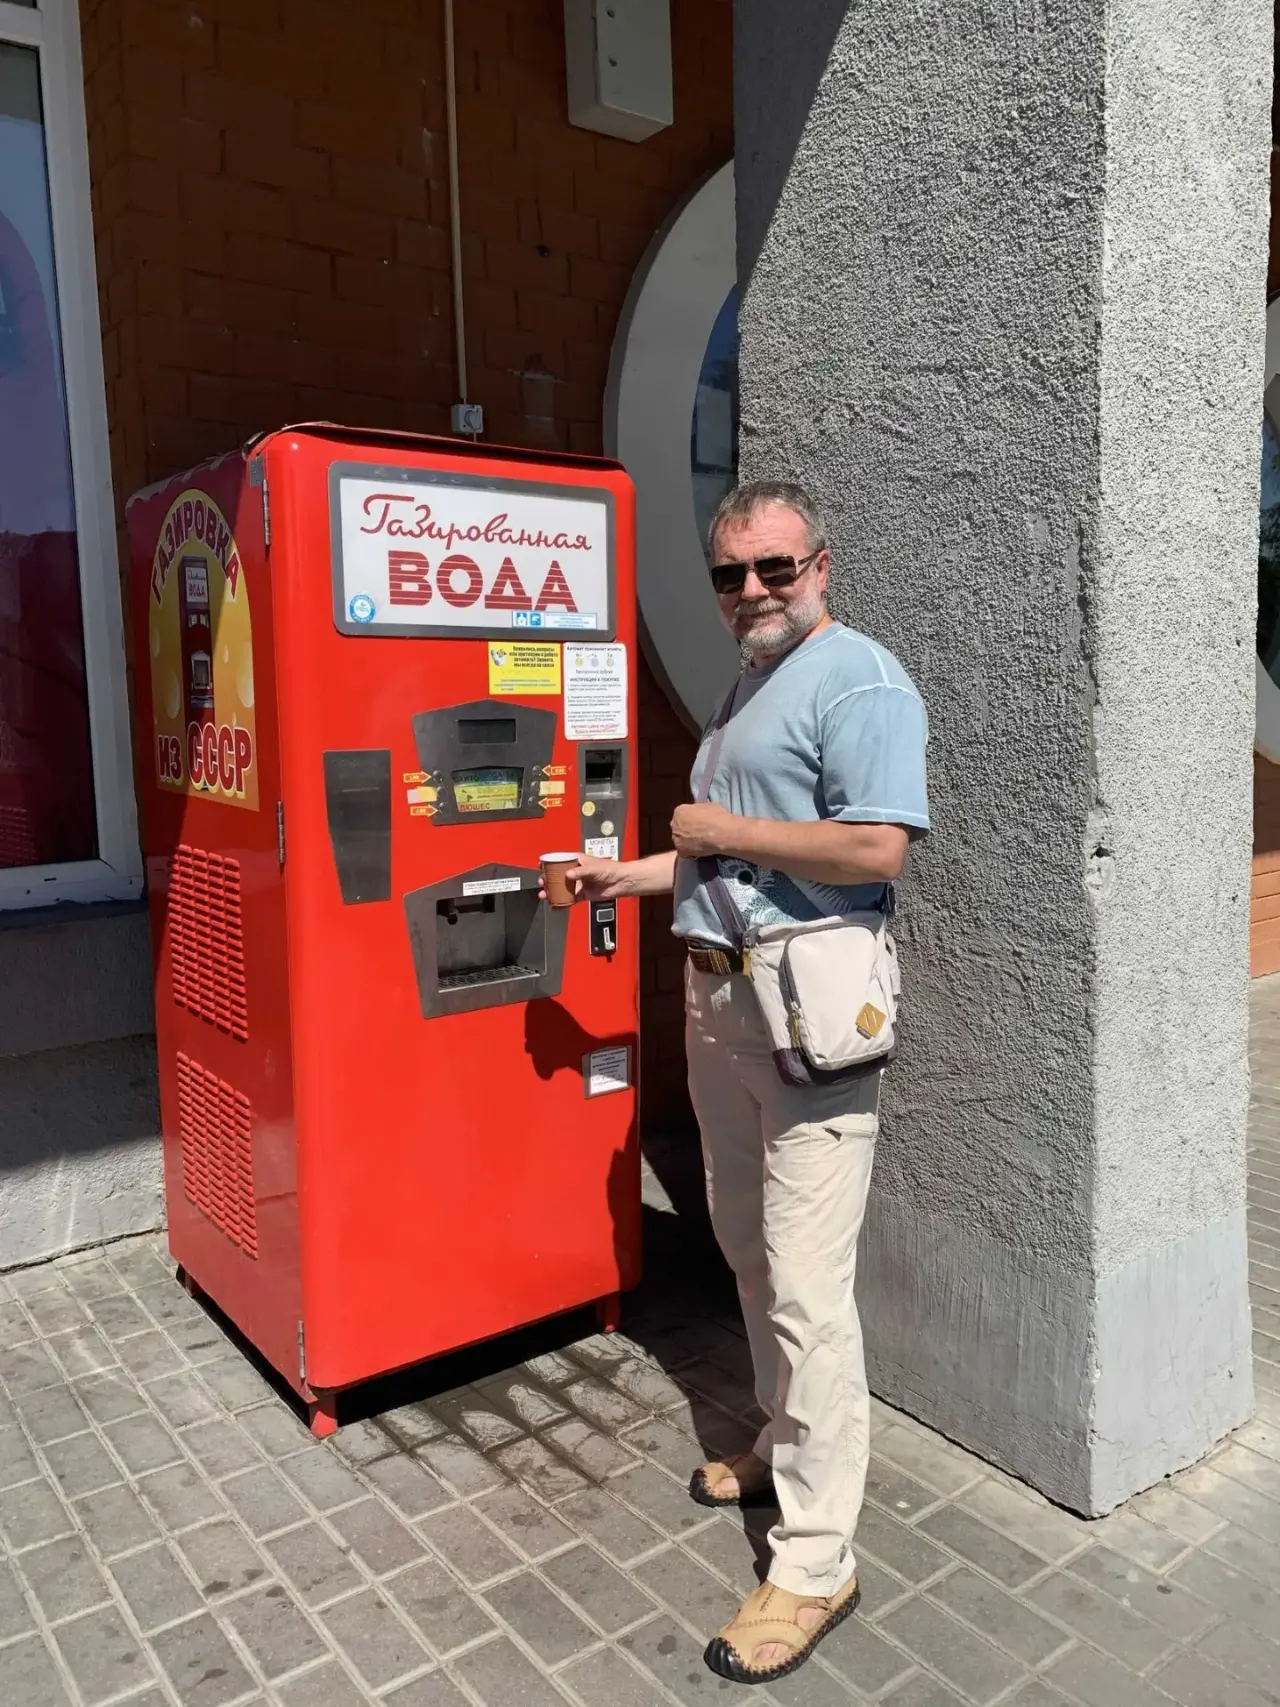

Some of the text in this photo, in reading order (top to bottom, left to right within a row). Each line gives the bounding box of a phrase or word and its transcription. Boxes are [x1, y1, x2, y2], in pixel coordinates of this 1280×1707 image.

[151, 499, 241, 609] ГАЗИРОВКА
[360, 493, 593, 551] Газированная
[388, 549, 579, 613] ВОДА
[157, 721, 253, 798] ИЗ СССР
